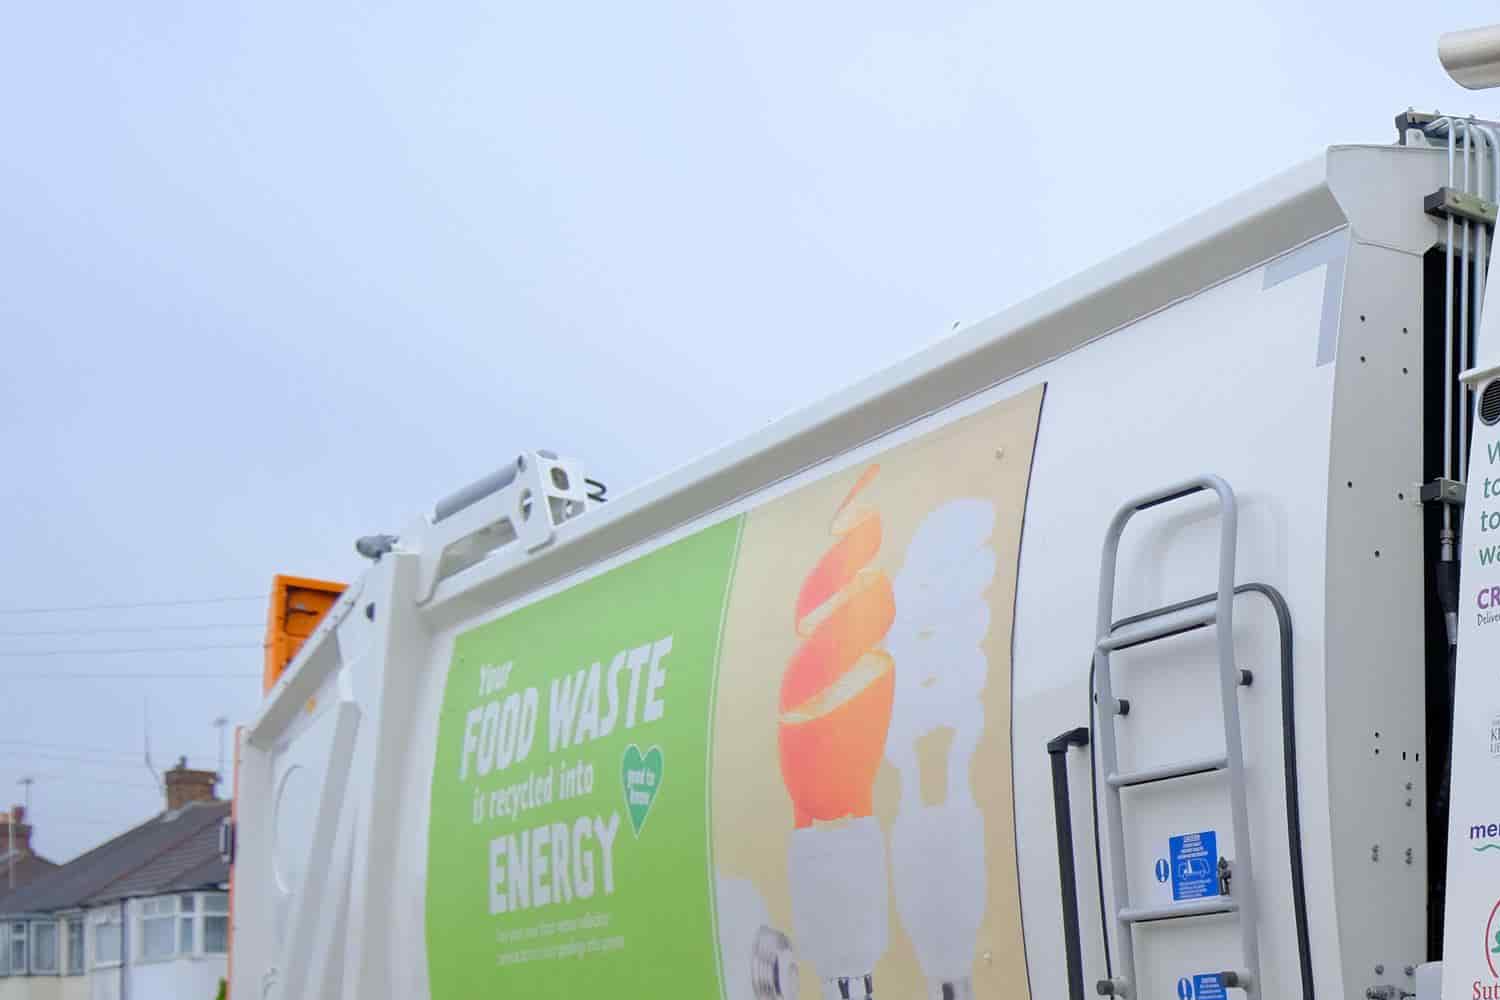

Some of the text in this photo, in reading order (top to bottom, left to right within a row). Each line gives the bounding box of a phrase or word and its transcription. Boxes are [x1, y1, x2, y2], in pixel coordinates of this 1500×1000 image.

[459, 635, 672, 782] FOOD WASTE
[472, 760, 594, 825] is recycled into
[488, 810, 619, 915] ENERGY
